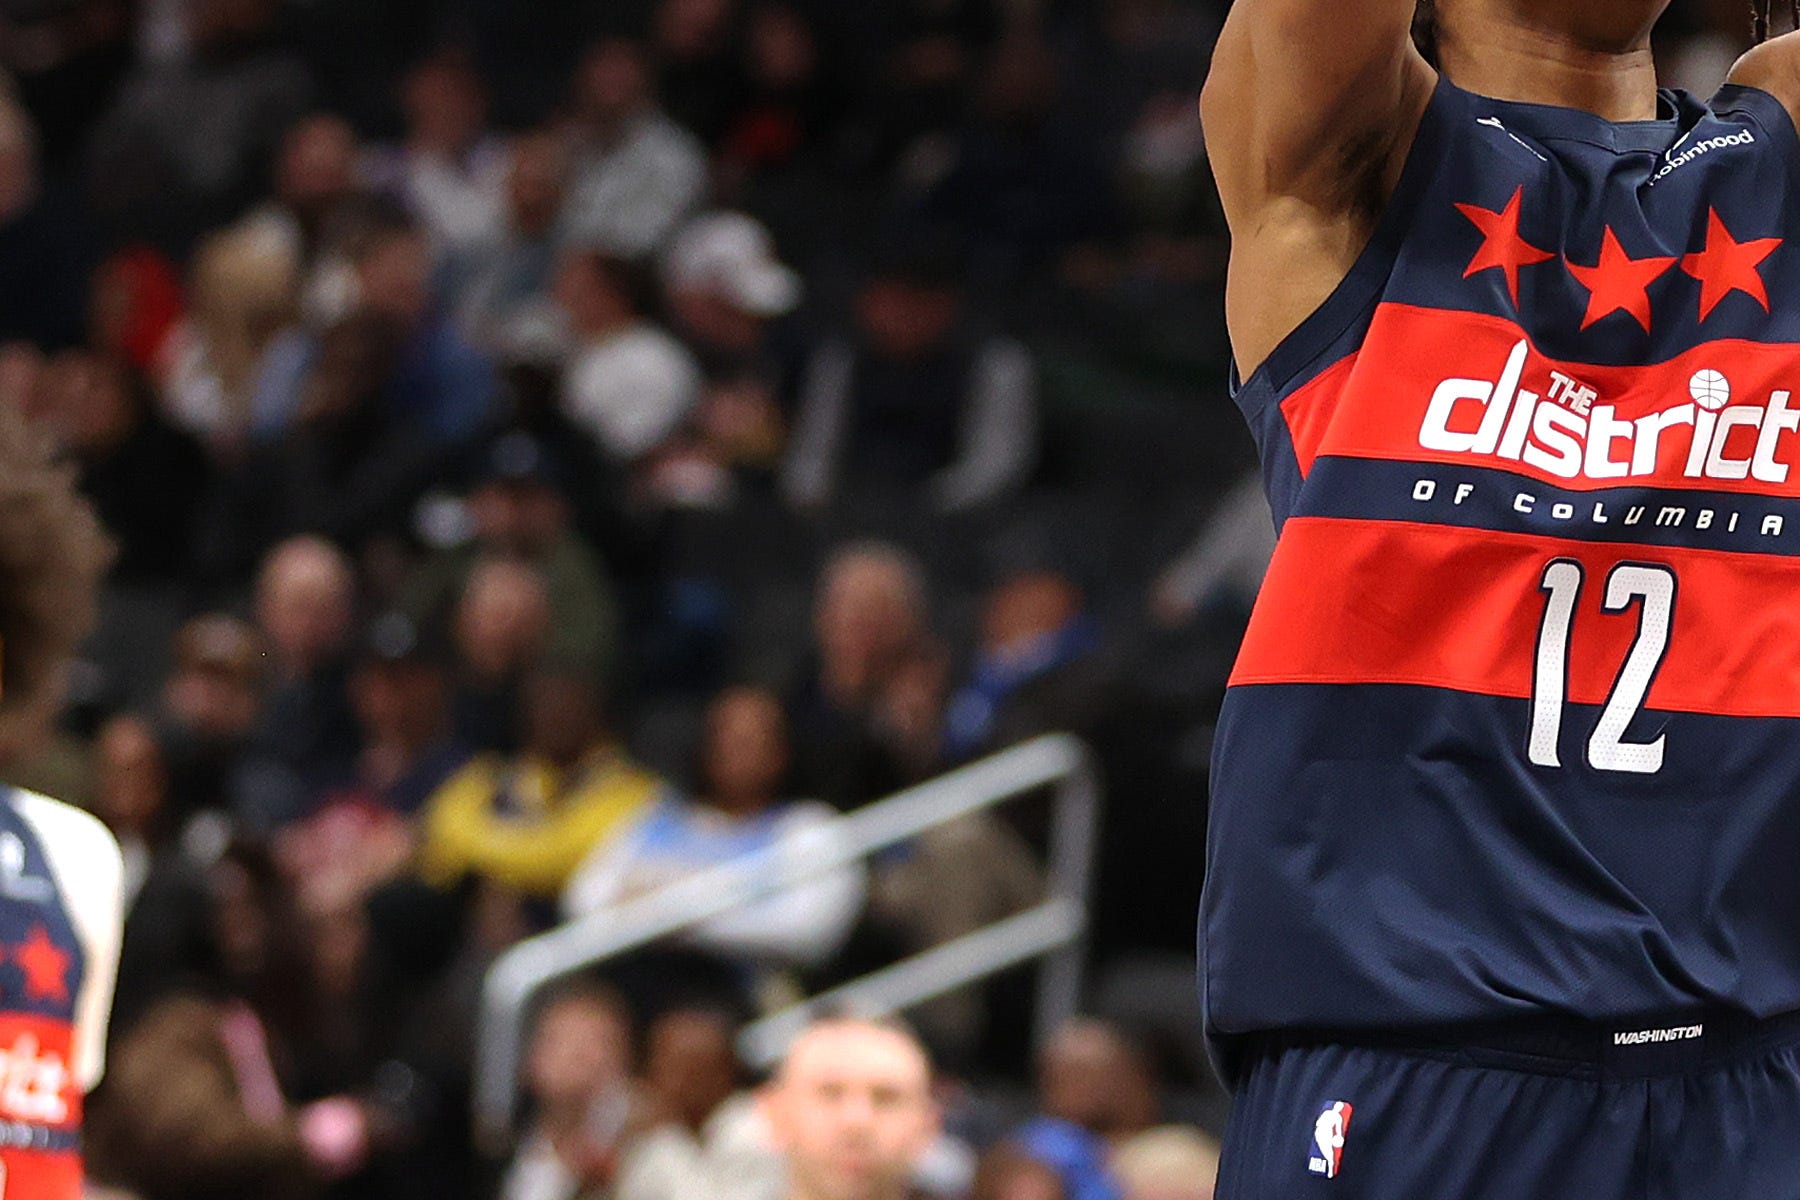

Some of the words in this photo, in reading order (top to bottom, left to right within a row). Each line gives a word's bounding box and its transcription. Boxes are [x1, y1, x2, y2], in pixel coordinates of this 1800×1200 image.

[1547, 370, 1599, 417] THE
[1412, 480, 1474, 505] OF
[1527, 560, 1673, 774] 12
[1614, 1024, 1702, 1045] WASHINGTON
